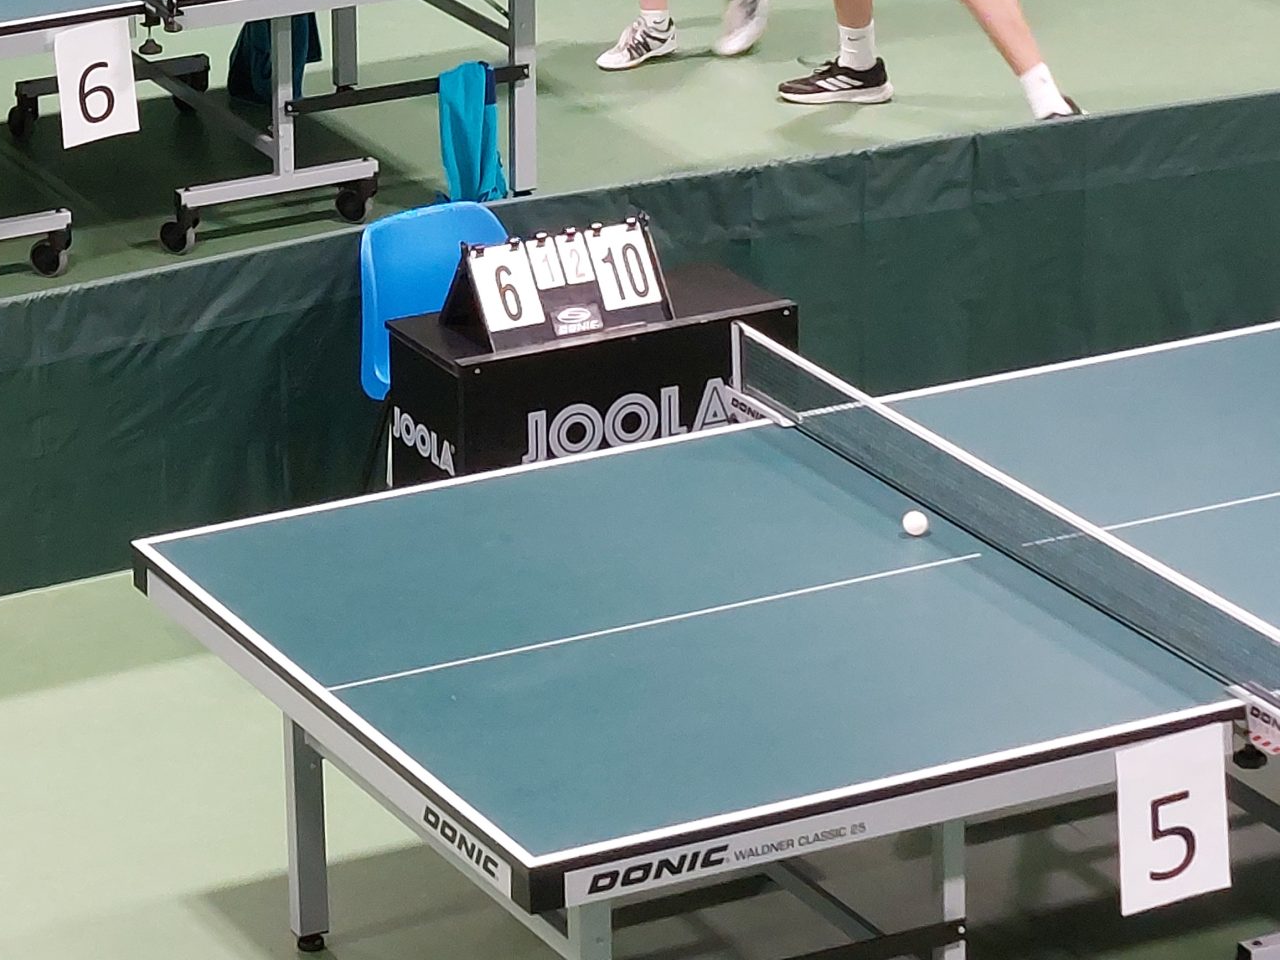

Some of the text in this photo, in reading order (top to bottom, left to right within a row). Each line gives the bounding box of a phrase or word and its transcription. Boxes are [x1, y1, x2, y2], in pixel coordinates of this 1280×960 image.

[79, 61, 115, 124] 6
[495, 242, 650, 322] 6 1 2 10
[392, 405, 456, 477] JOOLA
[522, 377, 731, 464] JOOLA
[423, 804, 499, 879] DONIC
[587, 843, 730, 895] DONIC
[733, 837, 796, 862] WALDNER
[797, 826, 848, 848] CLASSIC
[1149, 790, 1196, 881] 5
